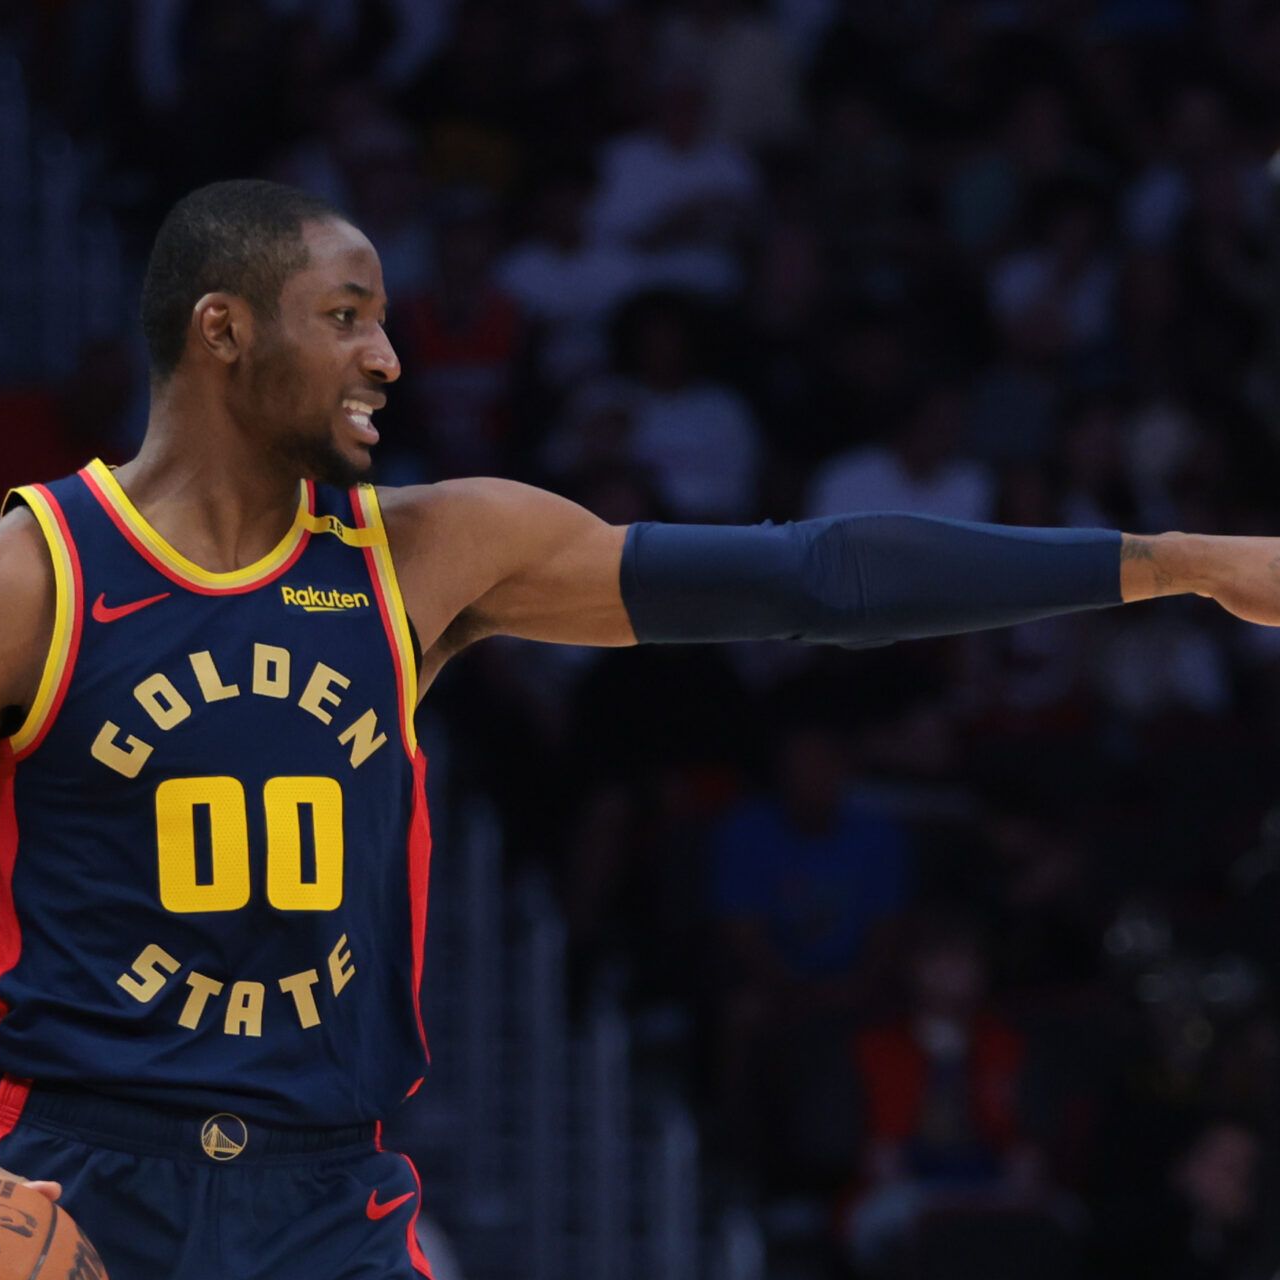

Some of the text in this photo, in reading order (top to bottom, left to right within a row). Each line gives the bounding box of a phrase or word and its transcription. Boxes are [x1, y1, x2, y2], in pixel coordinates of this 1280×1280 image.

[281, 585, 370, 610] Rakuten
[90, 642, 388, 779] GOLDEN
[155, 775, 344, 914] 00
[116, 933, 356, 1038] STATE
